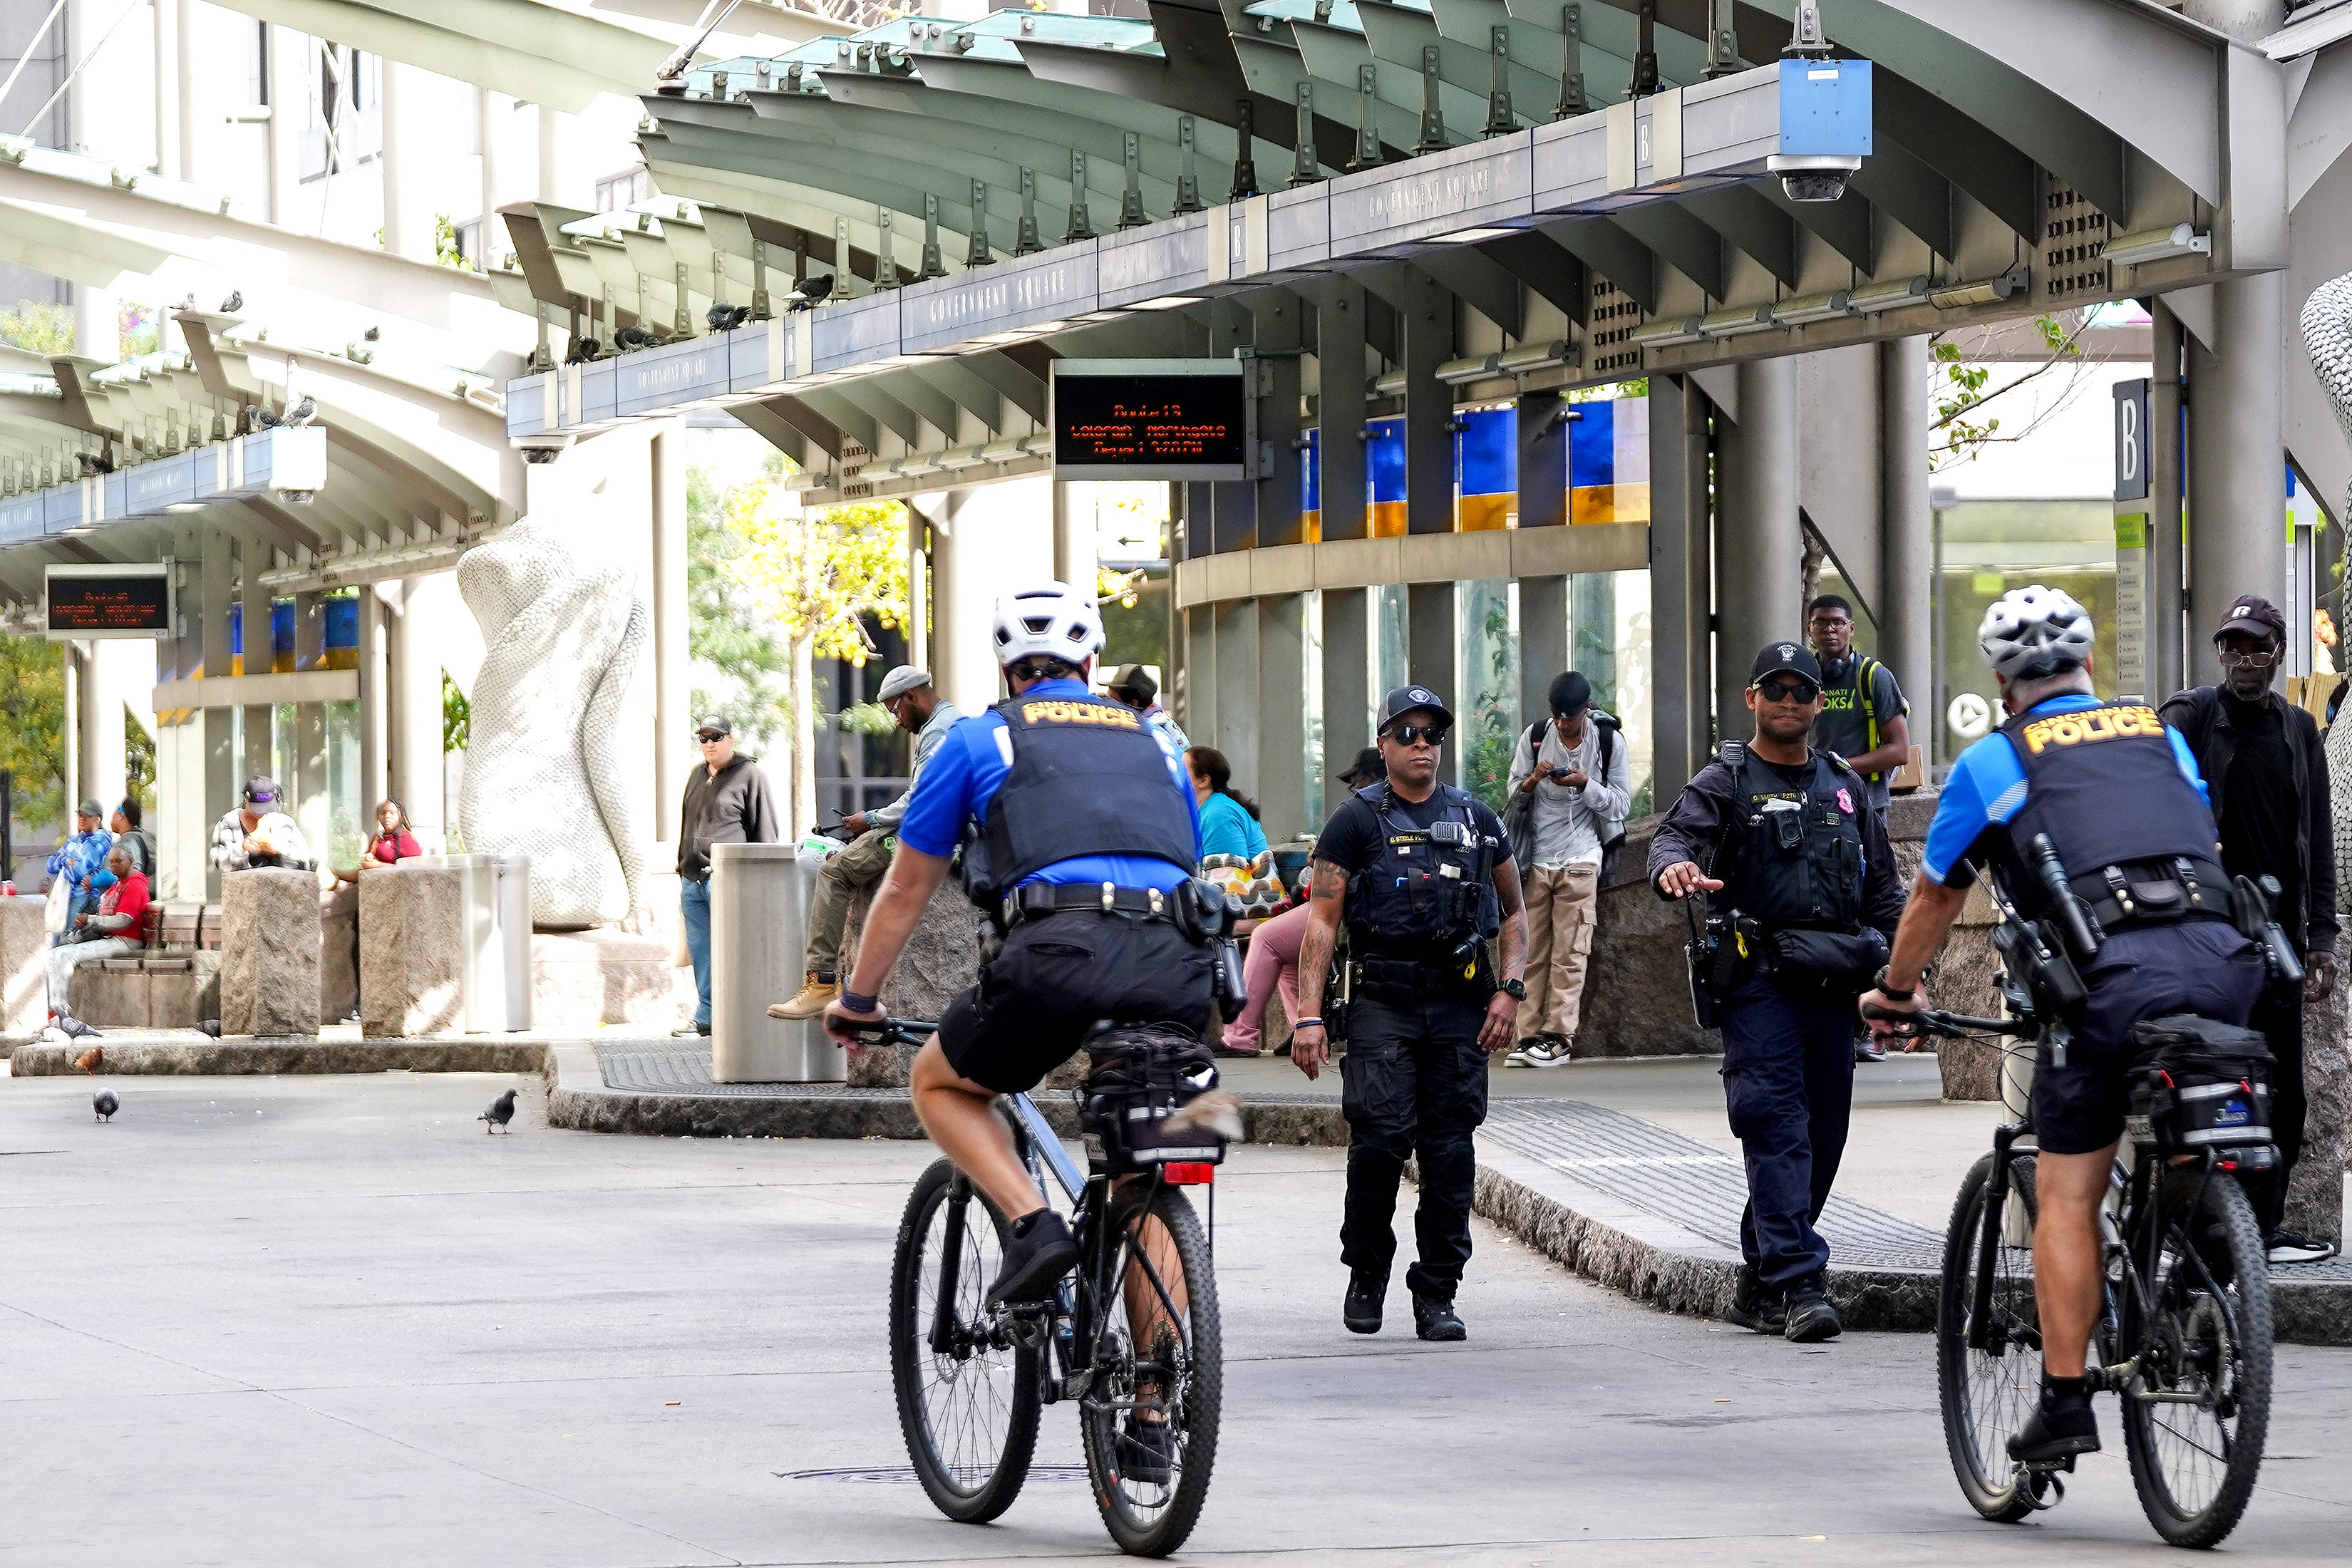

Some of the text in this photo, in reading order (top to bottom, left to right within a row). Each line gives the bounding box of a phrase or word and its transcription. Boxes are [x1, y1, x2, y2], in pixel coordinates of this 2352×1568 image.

[1641, 123, 1649, 162] B
[1446, 167, 1489, 202] SQUARE
[1234, 224, 1242, 257] B
[930, 269, 1065, 321] GOVERNMENT SQUARE
[788, 334, 794, 361] B
[2122, 398, 2137, 480] B
[1023, 706, 1141, 728] POLICE
[2025, 713, 2165, 755] POLICE
